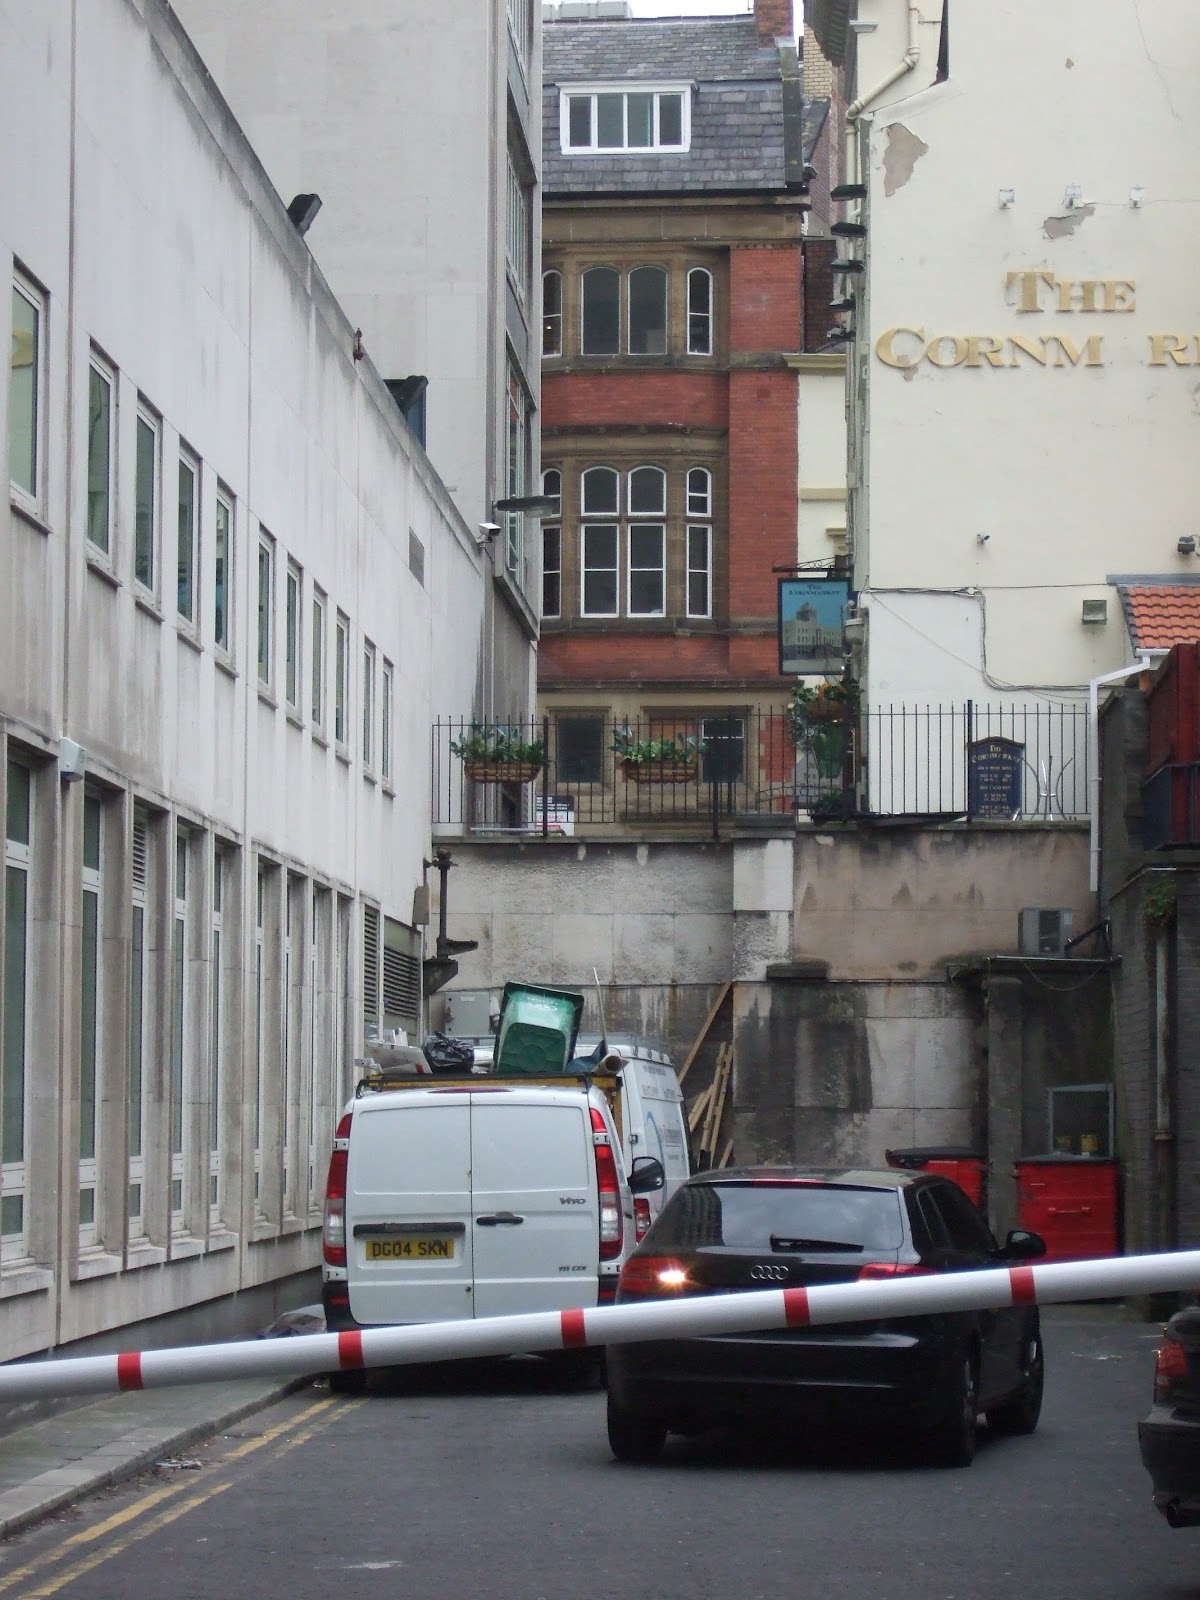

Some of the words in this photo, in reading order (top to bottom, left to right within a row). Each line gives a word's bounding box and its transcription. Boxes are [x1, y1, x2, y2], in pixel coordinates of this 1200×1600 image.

[1005, 271, 1137, 314] THE
[875, 327, 1105, 368] CORNM
[371, 1241, 412, 1257] DG04
[418, 1240, 449, 1257] SKN
